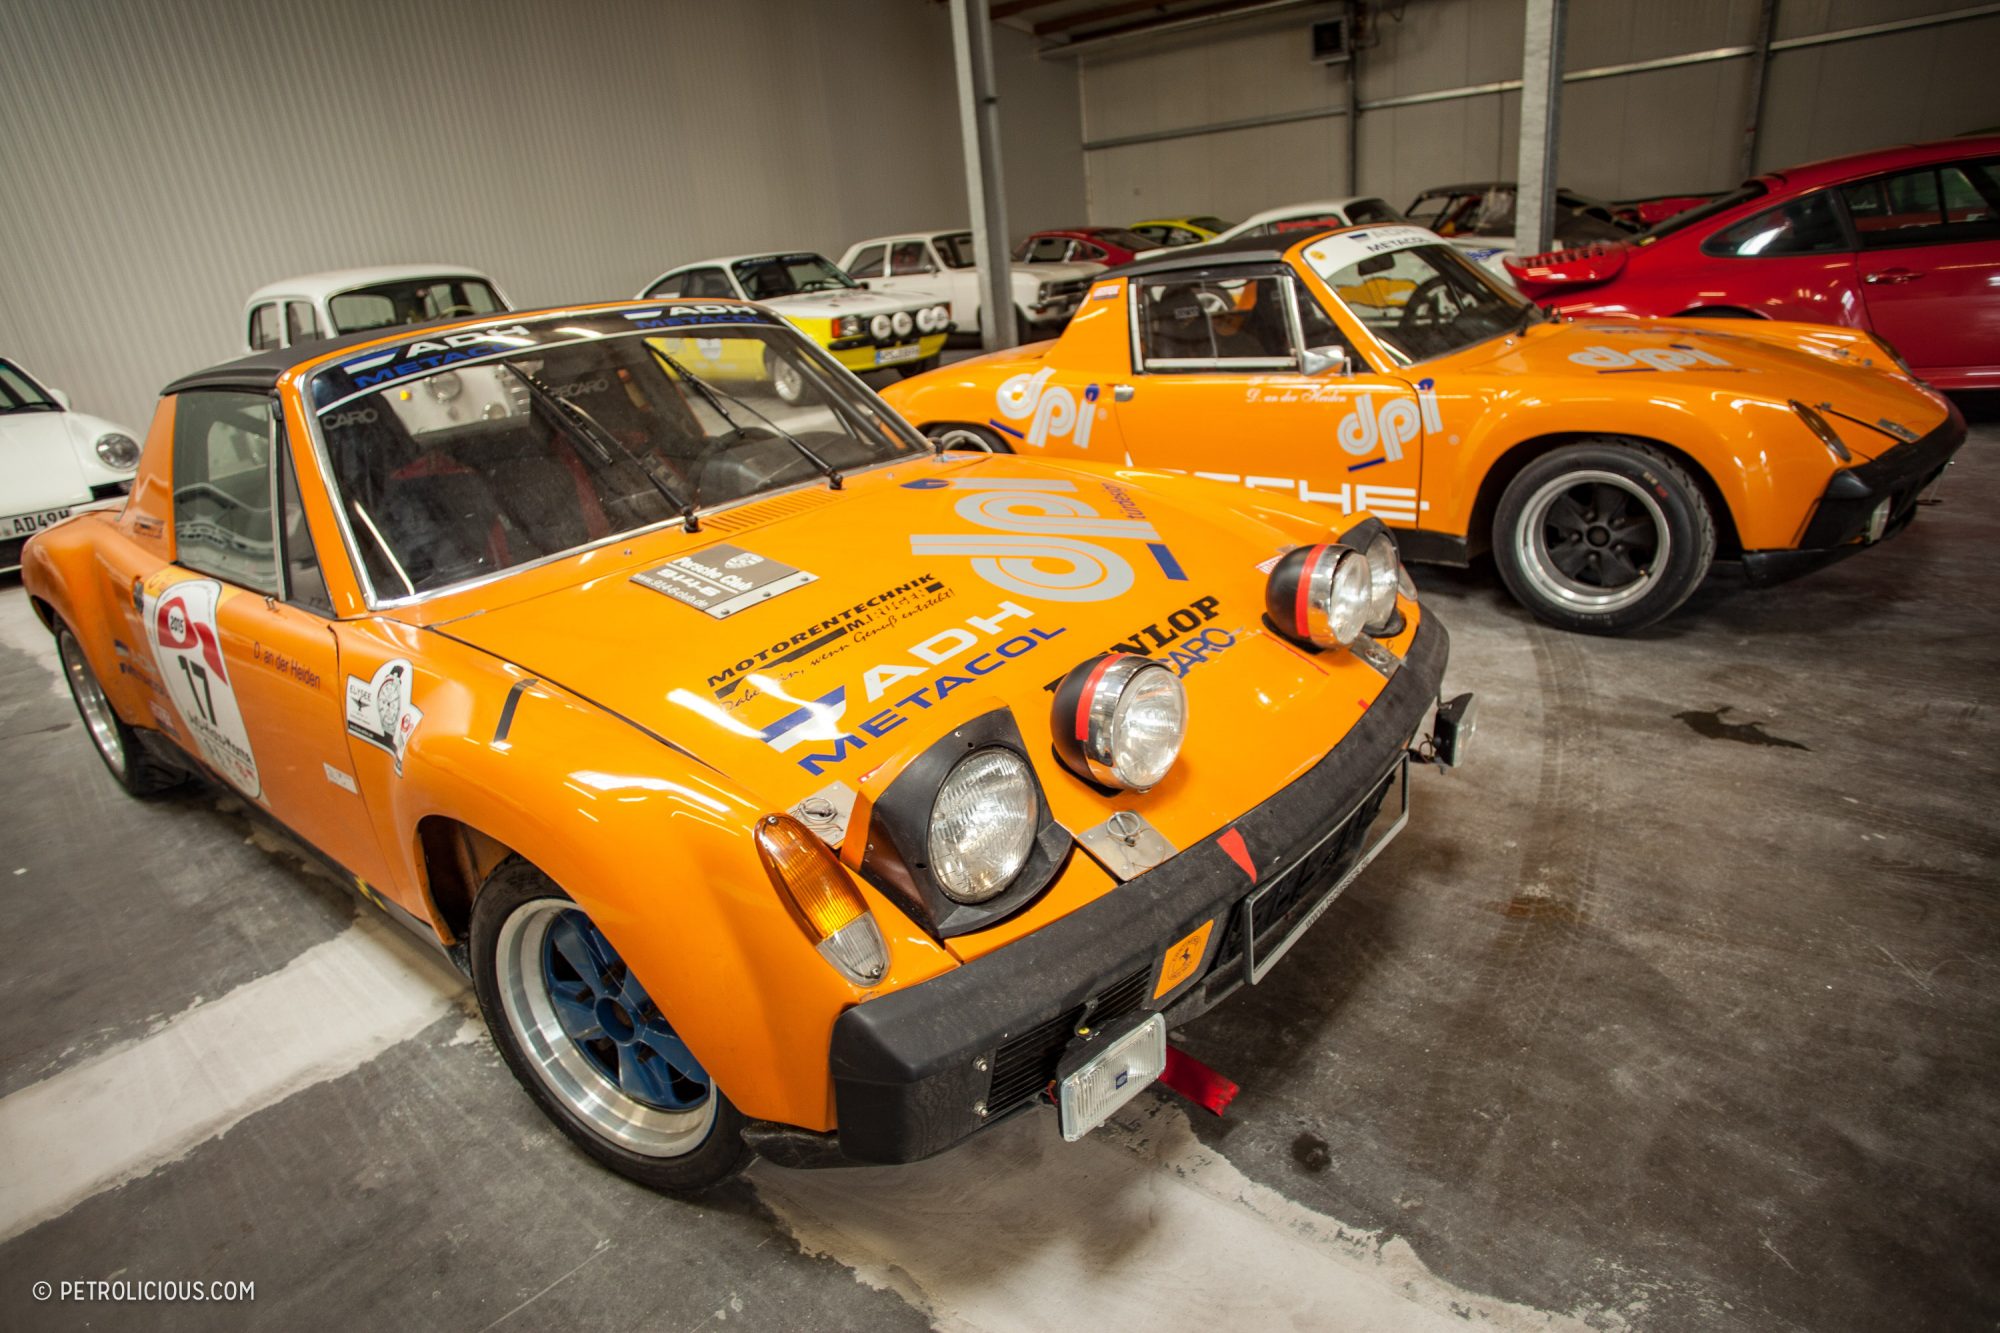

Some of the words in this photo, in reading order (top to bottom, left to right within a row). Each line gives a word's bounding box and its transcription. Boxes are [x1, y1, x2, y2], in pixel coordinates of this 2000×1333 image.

[635, 315, 769, 328] METACOL
[669, 305, 758, 316] ADH
[405, 325, 530, 358] ADH
[354, 343, 519, 388] METACO
[995, 366, 1100, 449] dpi
[1337, 378, 1444, 462] dpi
[671, 556, 724, 579] Porsche
[720, 574, 753, 591] Club
[169, 614, 185, 634] 2015
[706, 572, 936, 688] MOTORENTECHNIK
[290, 658, 321, 690] Heiden
[862, 600, 1035, 703] ADH
[178, 655, 217, 726] 17
[797, 627, 1067, 776] METACOL
